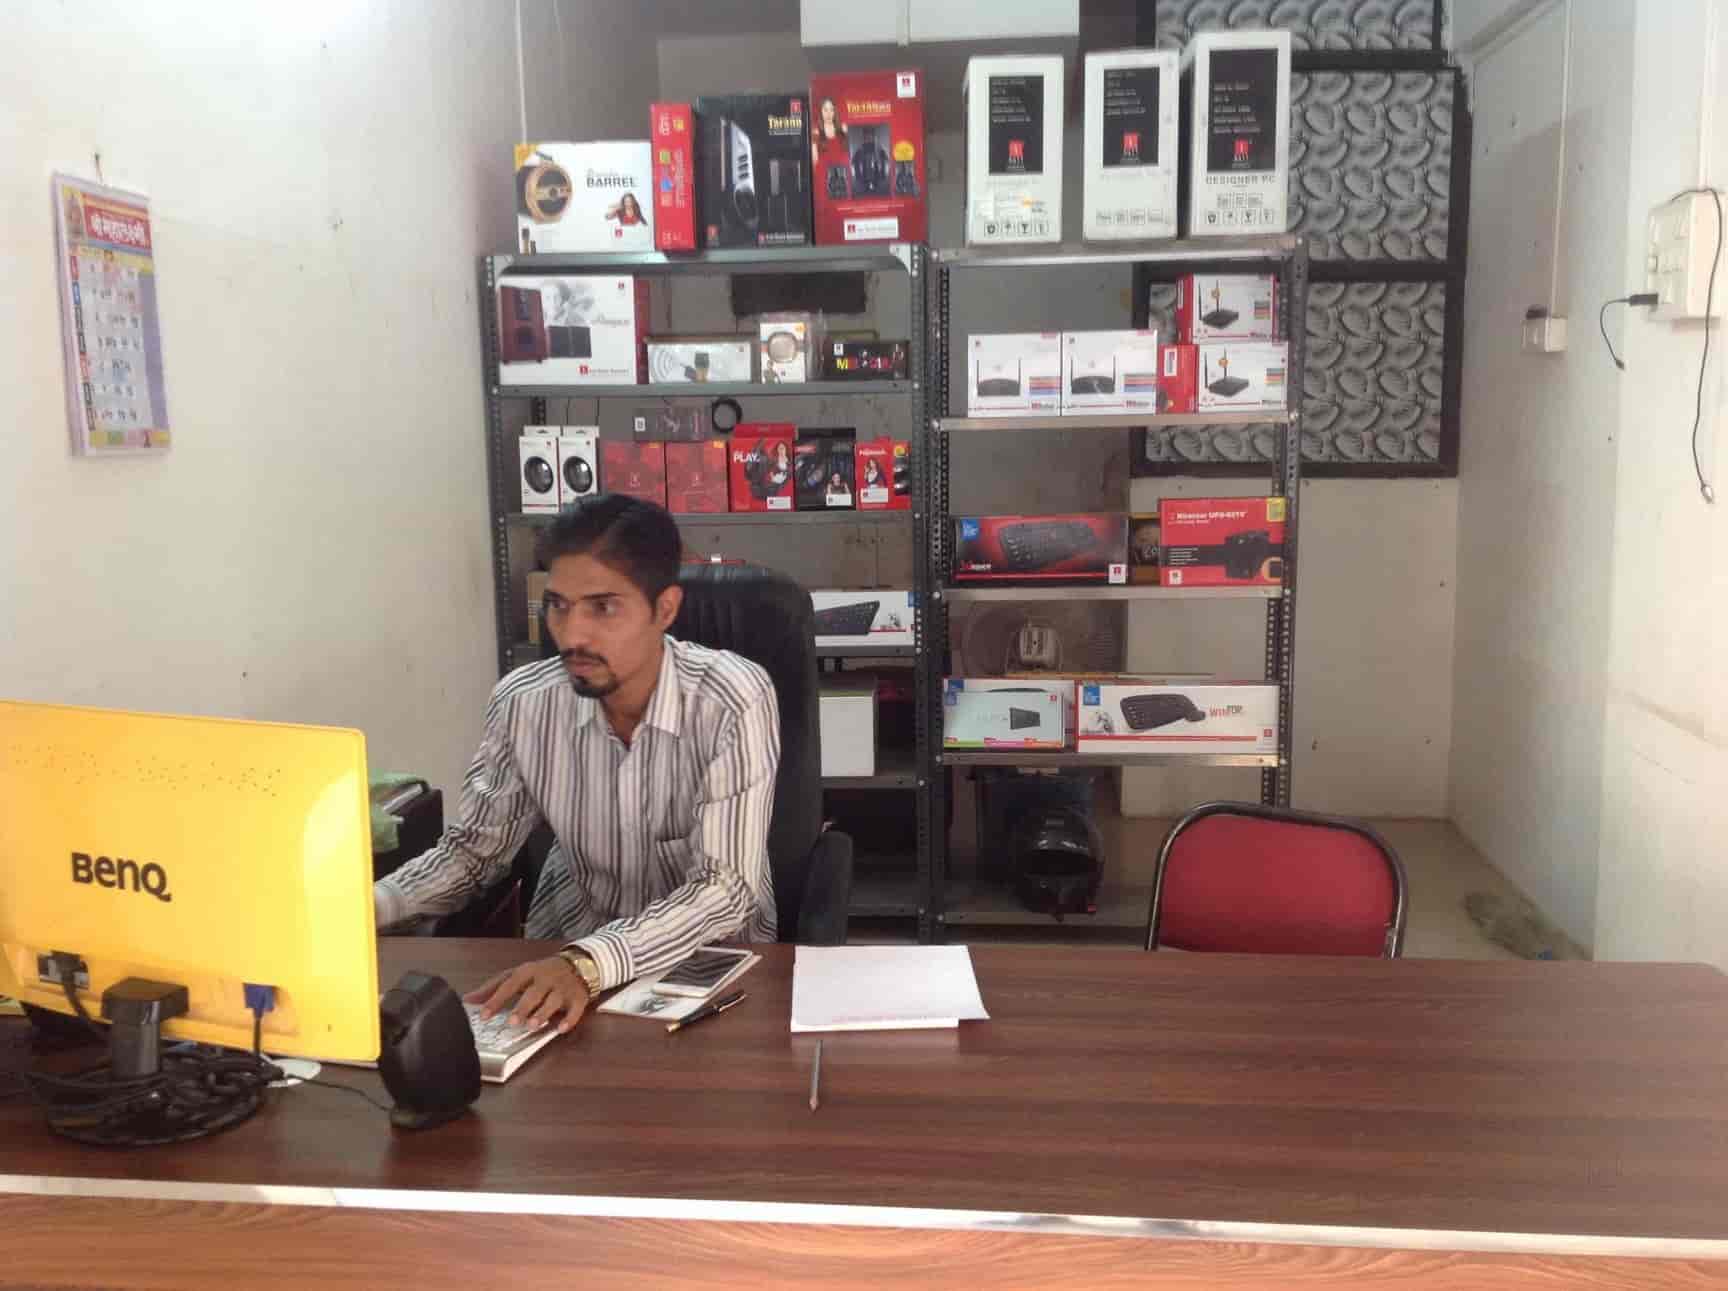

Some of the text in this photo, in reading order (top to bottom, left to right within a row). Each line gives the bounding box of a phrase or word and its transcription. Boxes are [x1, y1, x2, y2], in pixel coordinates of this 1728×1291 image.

[586, 177, 638, 189] BARREL
[1206, 175, 1258, 185] DESIGNER
[71, 851, 172, 903] BenQ
